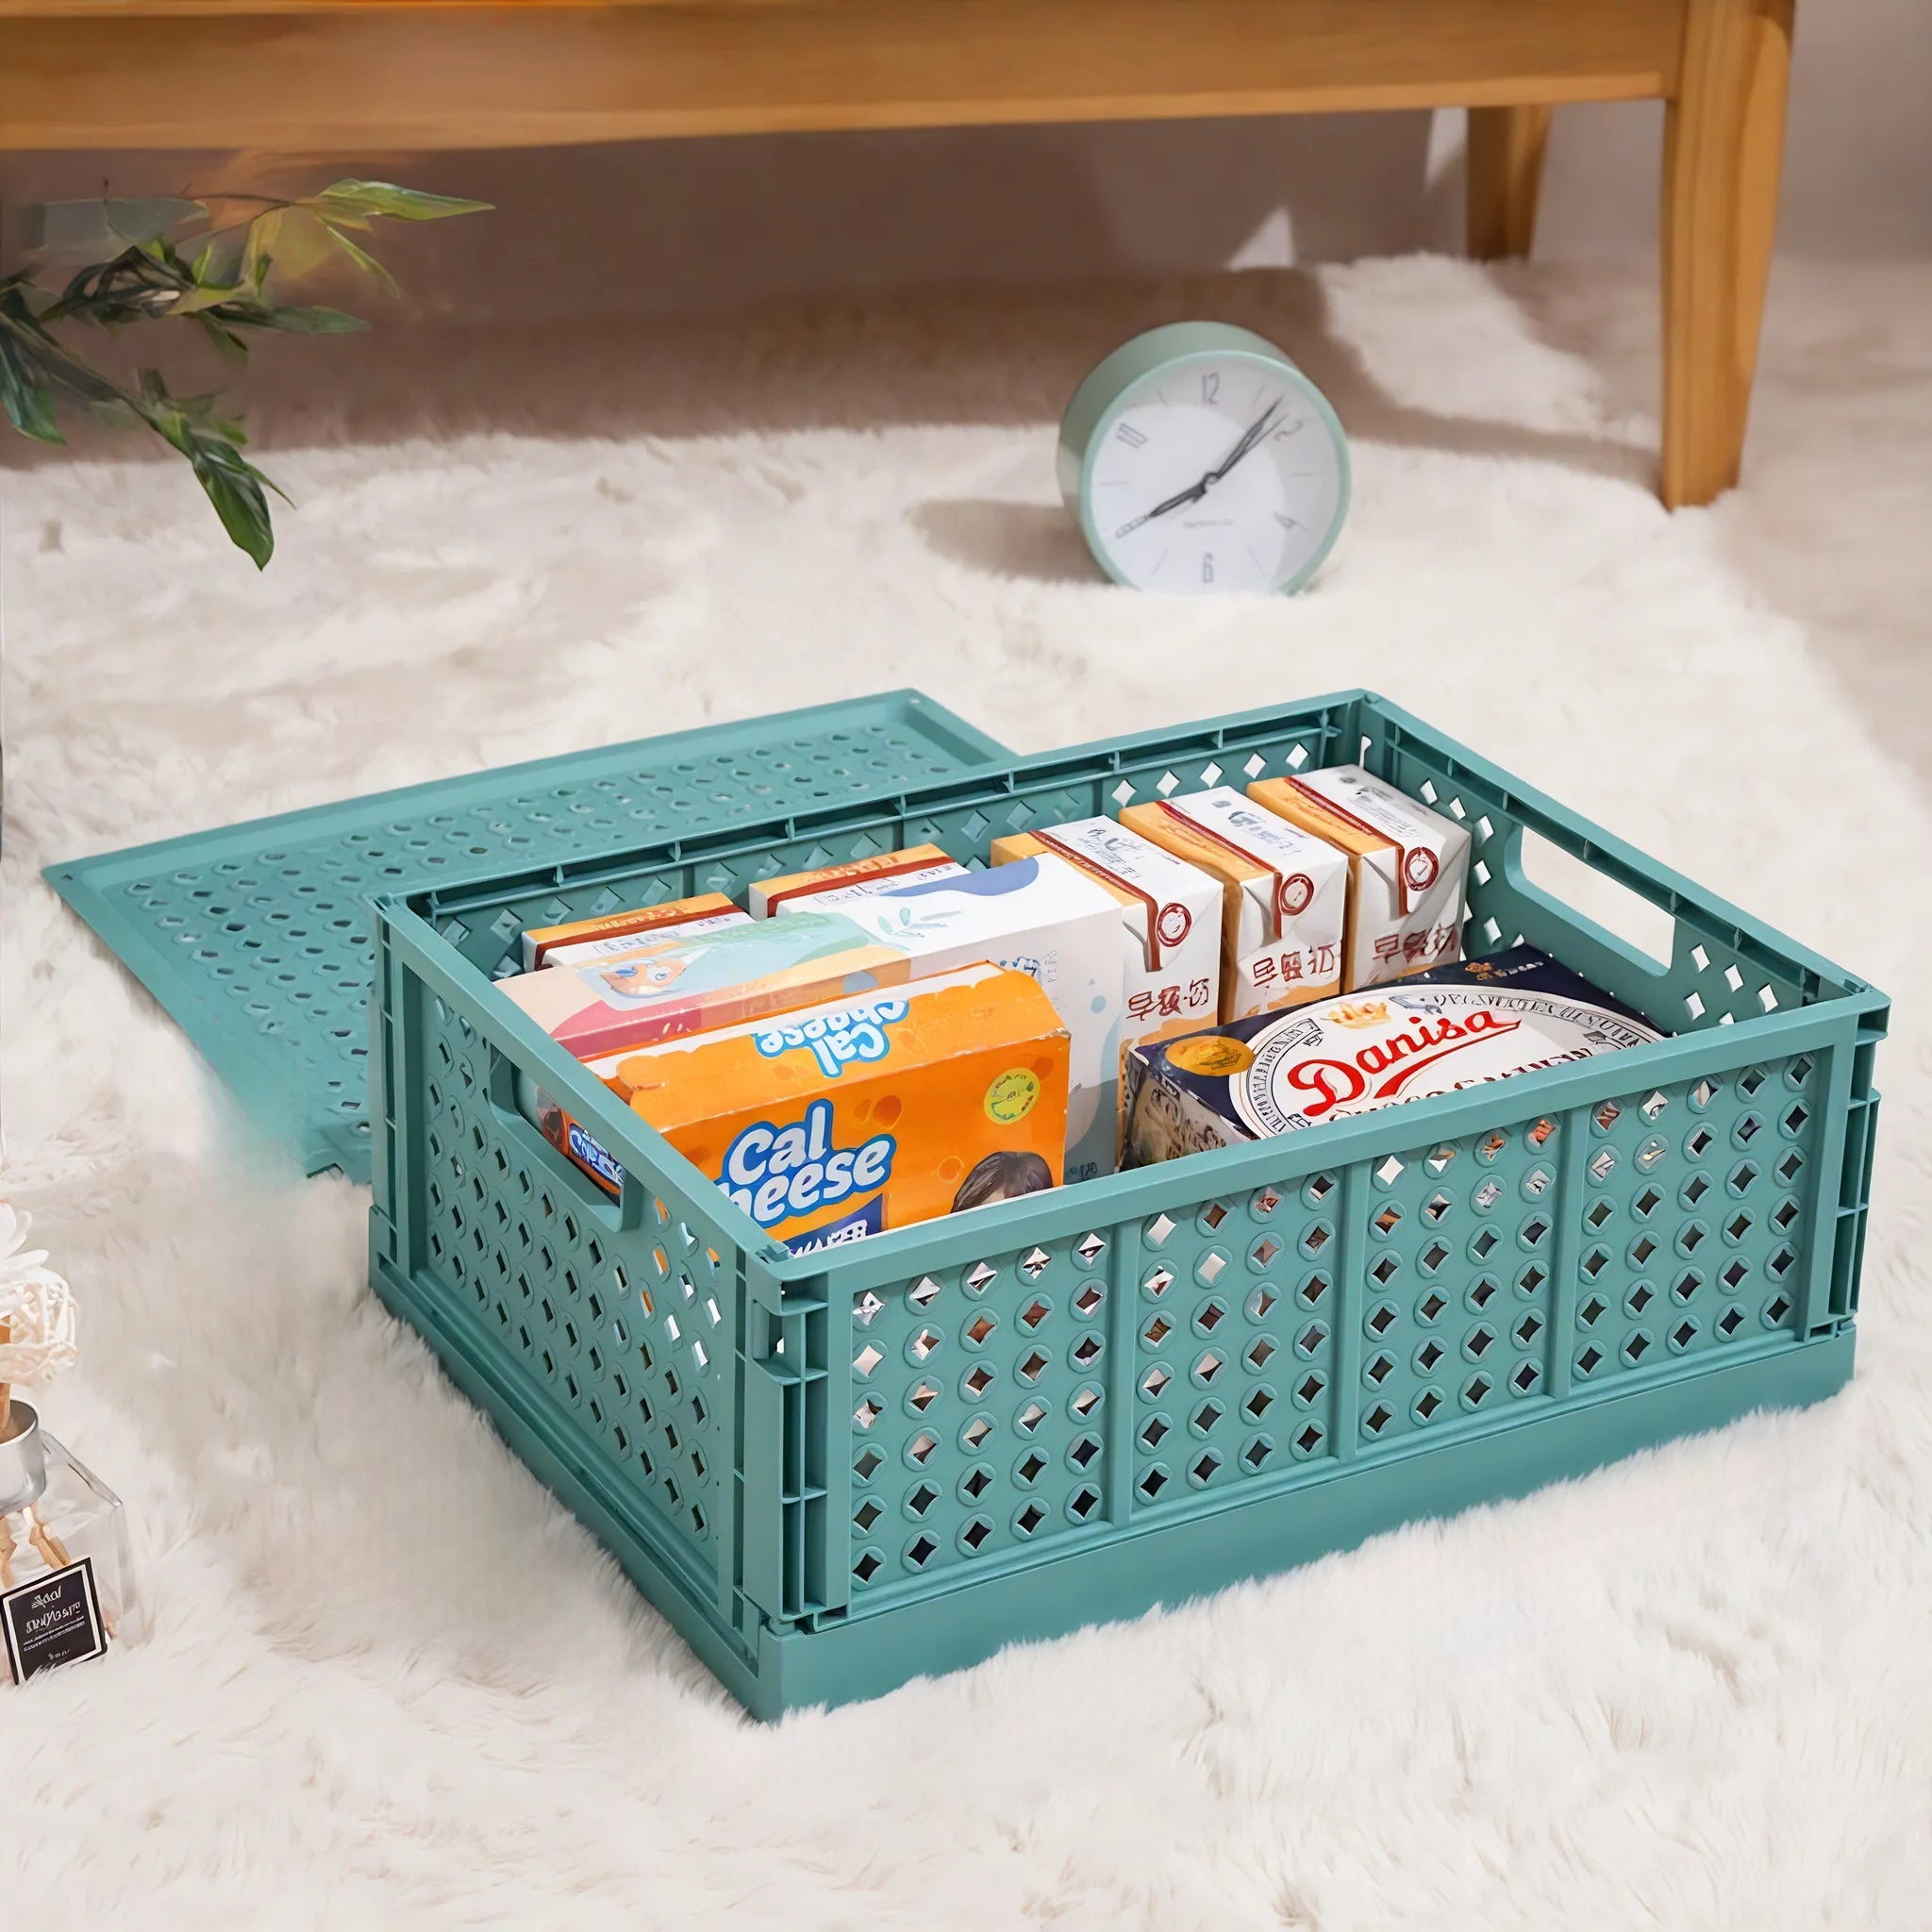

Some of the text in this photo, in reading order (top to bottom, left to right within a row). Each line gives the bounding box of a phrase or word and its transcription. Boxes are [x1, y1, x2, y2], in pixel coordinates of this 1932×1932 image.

[1201, 372, 1220, 406] 12
[1201, 552, 1214, 584] 6
[811, 1023, 885, 1074] Cal
[1287, 1009, 1523, 1118] Danisa
[728, 1105, 827, 1185] Cal
[715, 1139, 891, 1222] heese
